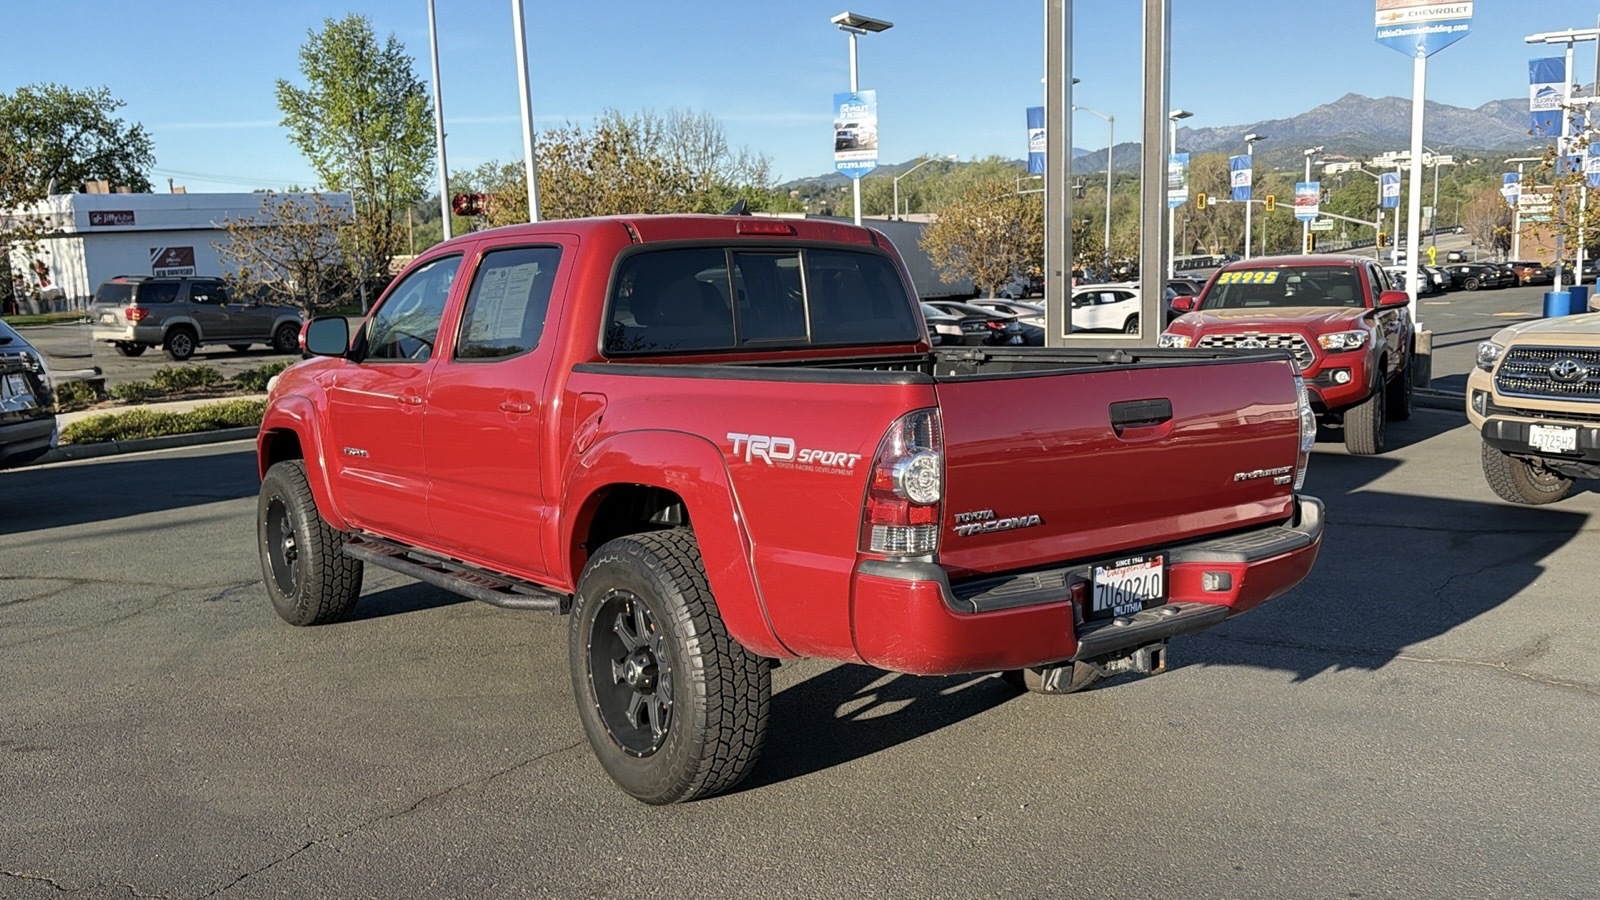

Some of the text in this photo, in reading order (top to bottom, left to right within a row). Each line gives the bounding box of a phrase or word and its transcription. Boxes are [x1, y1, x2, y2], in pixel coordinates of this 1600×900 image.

[1408, 6, 1468, 17] CHEVROLET
[1377, 24, 1469, 39] LithiaChevroletRedding.com
[1217, 271, 1279, 284] 39995
[727, 432, 861, 468] TRD SPORT
[795, 464, 814, 472] RACING
[815, 466, 854, 476] DEVELOPMENT
[954, 509, 994, 522] TOYOTA
[952, 514, 1041, 536] TACOMA
[1115, 558, 1131, 567] SINCE
[1096, 573, 1160, 610] 7U60240
[1120, 601, 1143, 615] LITHIA
